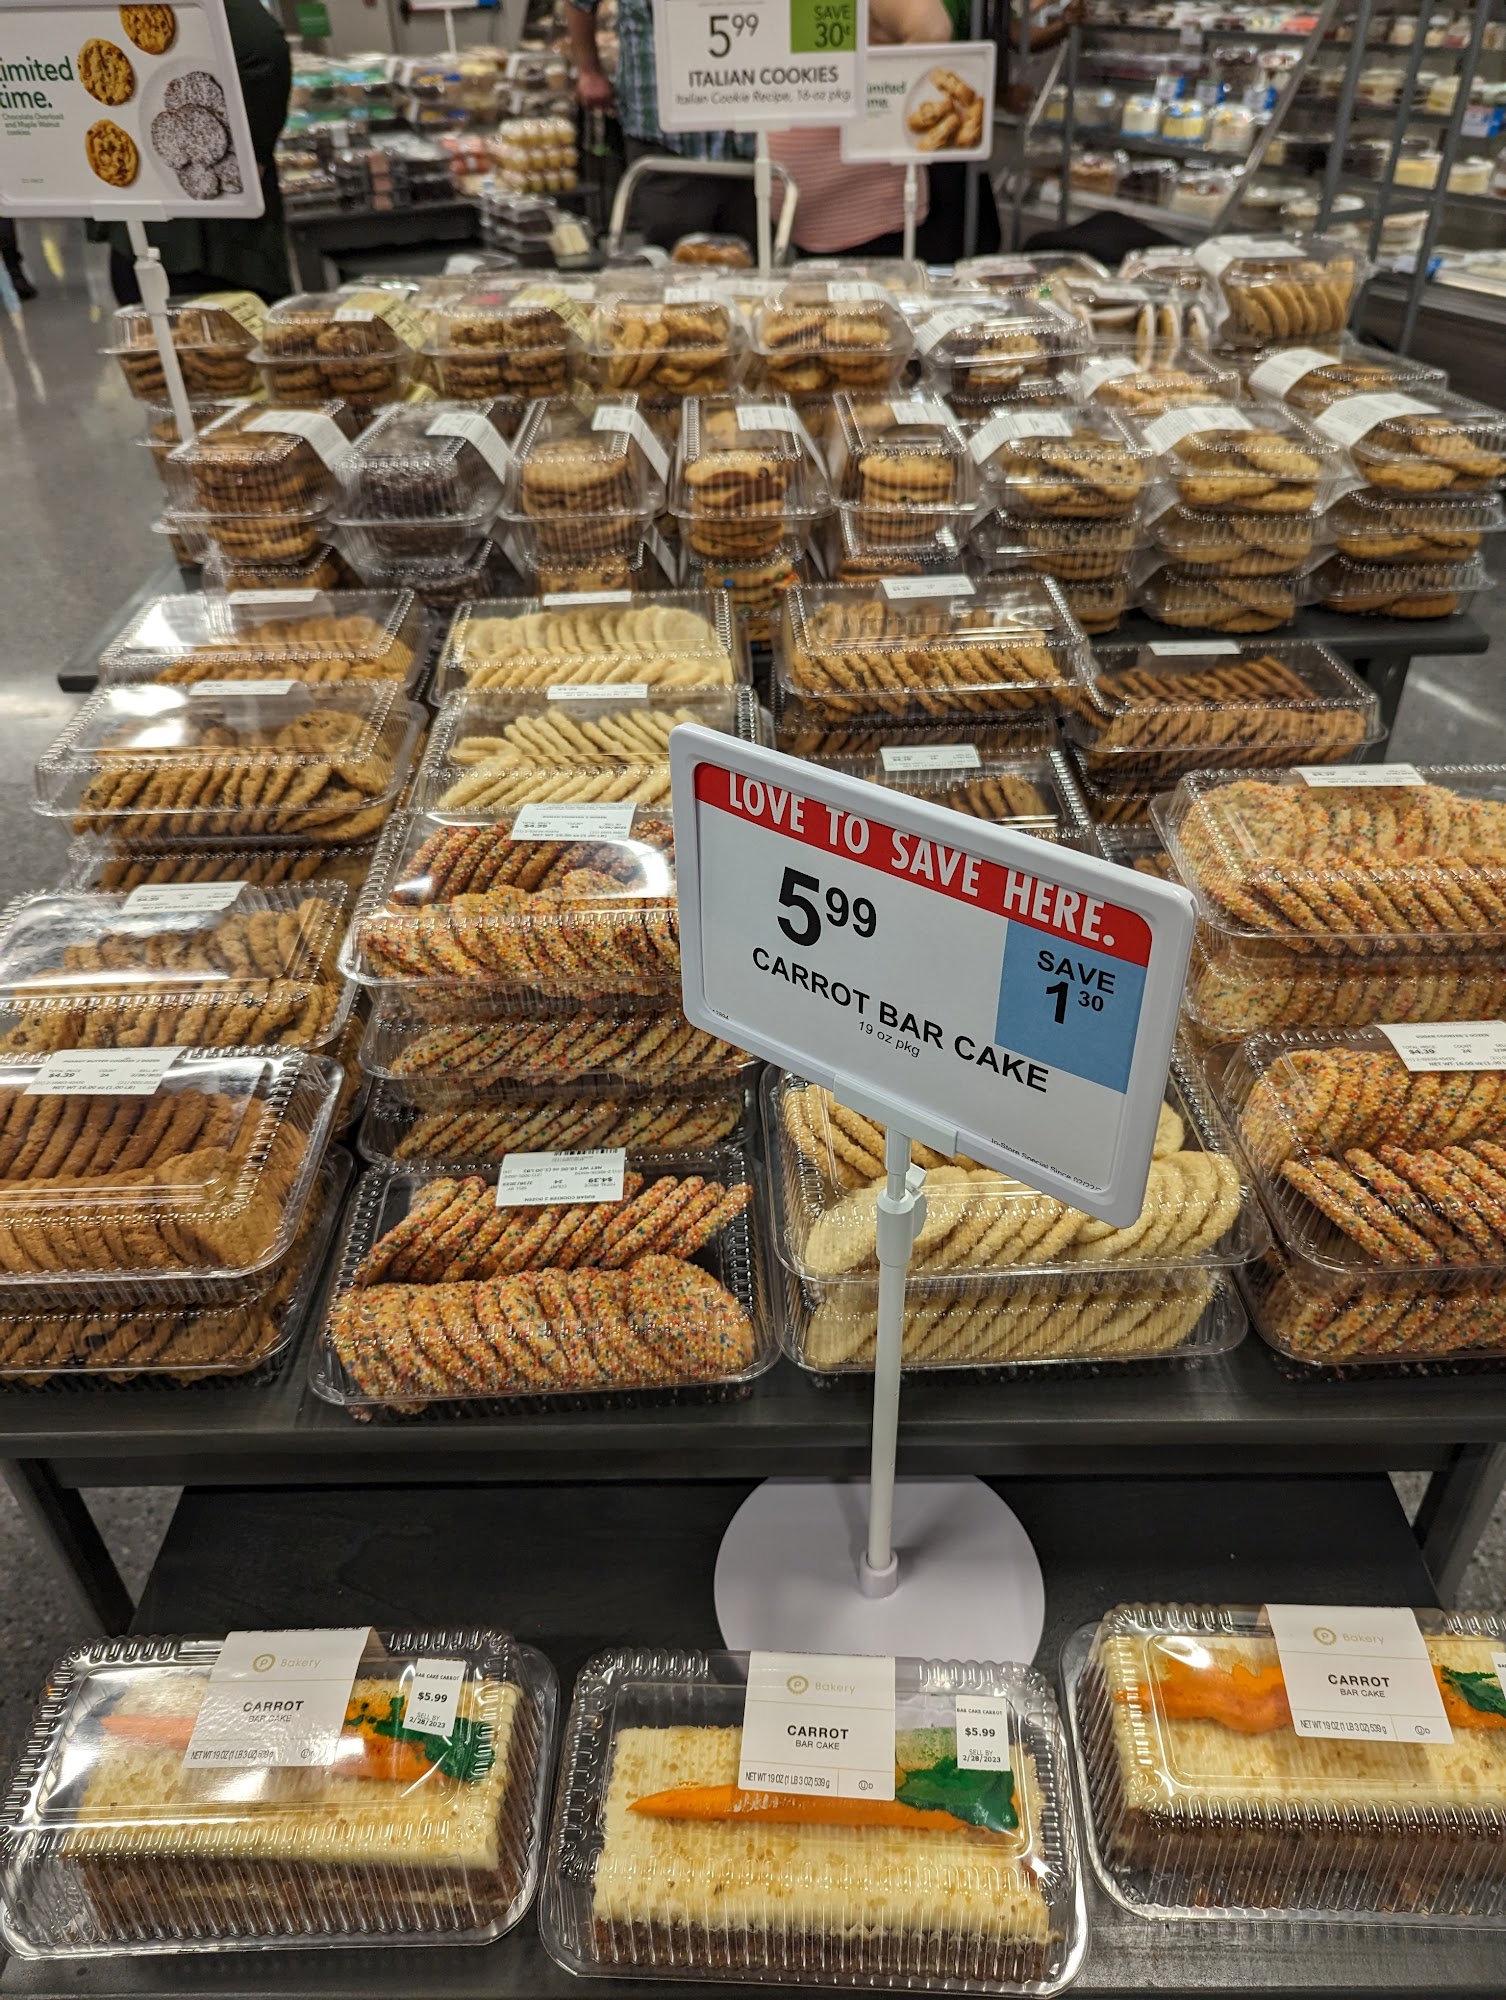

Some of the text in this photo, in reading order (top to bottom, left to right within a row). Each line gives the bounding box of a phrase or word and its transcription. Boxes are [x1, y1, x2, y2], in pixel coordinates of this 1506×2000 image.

[814, 5, 850, 20] SAVE
[0, 55, 74, 82] imited
[689, 66, 839, 87] ITALIAN COOKIES
[866, 81, 906, 95] imited
[729, 771, 1115, 948] LOVE TO SAVE HERE.
[1037, 950, 1116, 995] SAVE
[752, 947, 1049, 1093] CARROT BAR CAKE
[858, 1021, 921, 1059] 19 oz pkg
[991, 1137, 1020, 1156] In-Store
[1343, 1632, 1384, 1646] Bakery
[280, 1657, 323, 1669] Bakery
[815, 1680, 856, 1694] Bakery
[1327, 1674, 1390, 1688] CARROT
[417, 1691, 448, 1703] $5.99
[1340, 1688, 1386, 1698] BAR CAKE
[243, 1700, 304, 1713] CARROT
[247, 1714, 292, 1723] BAR CAKE
[409, 1716, 446, 1729] 2/28/2023
[416, 1711, 430, 1721] SELL
[787, 1724, 850, 1740] CARROT
[964, 1727, 996, 1738] $5.99
[1300, 1719, 1388, 1735] NET WT 19 OZ (1 LB 3 OZ) 539 g
[795, 1739, 840, 1751] BAR CAKE
[968, 1748, 984, 1756] SELL
[190, 1750, 203, 1760] NET
[202, 1750, 213, 1760] WT
[213, 1750, 220, 1760] 19
[221, 1750, 230, 1760] OZ
[228, 1750, 234, 1761] (1
[234, 1750, 243, 1760] LB
[243, 1750, 248, 1760] 3
[962, 1754, 1001, 1763] 2/28/2023
[745, 1771, 830, 1790] NET WT 19 OZ (1 LB 3 OZ) 539 g
